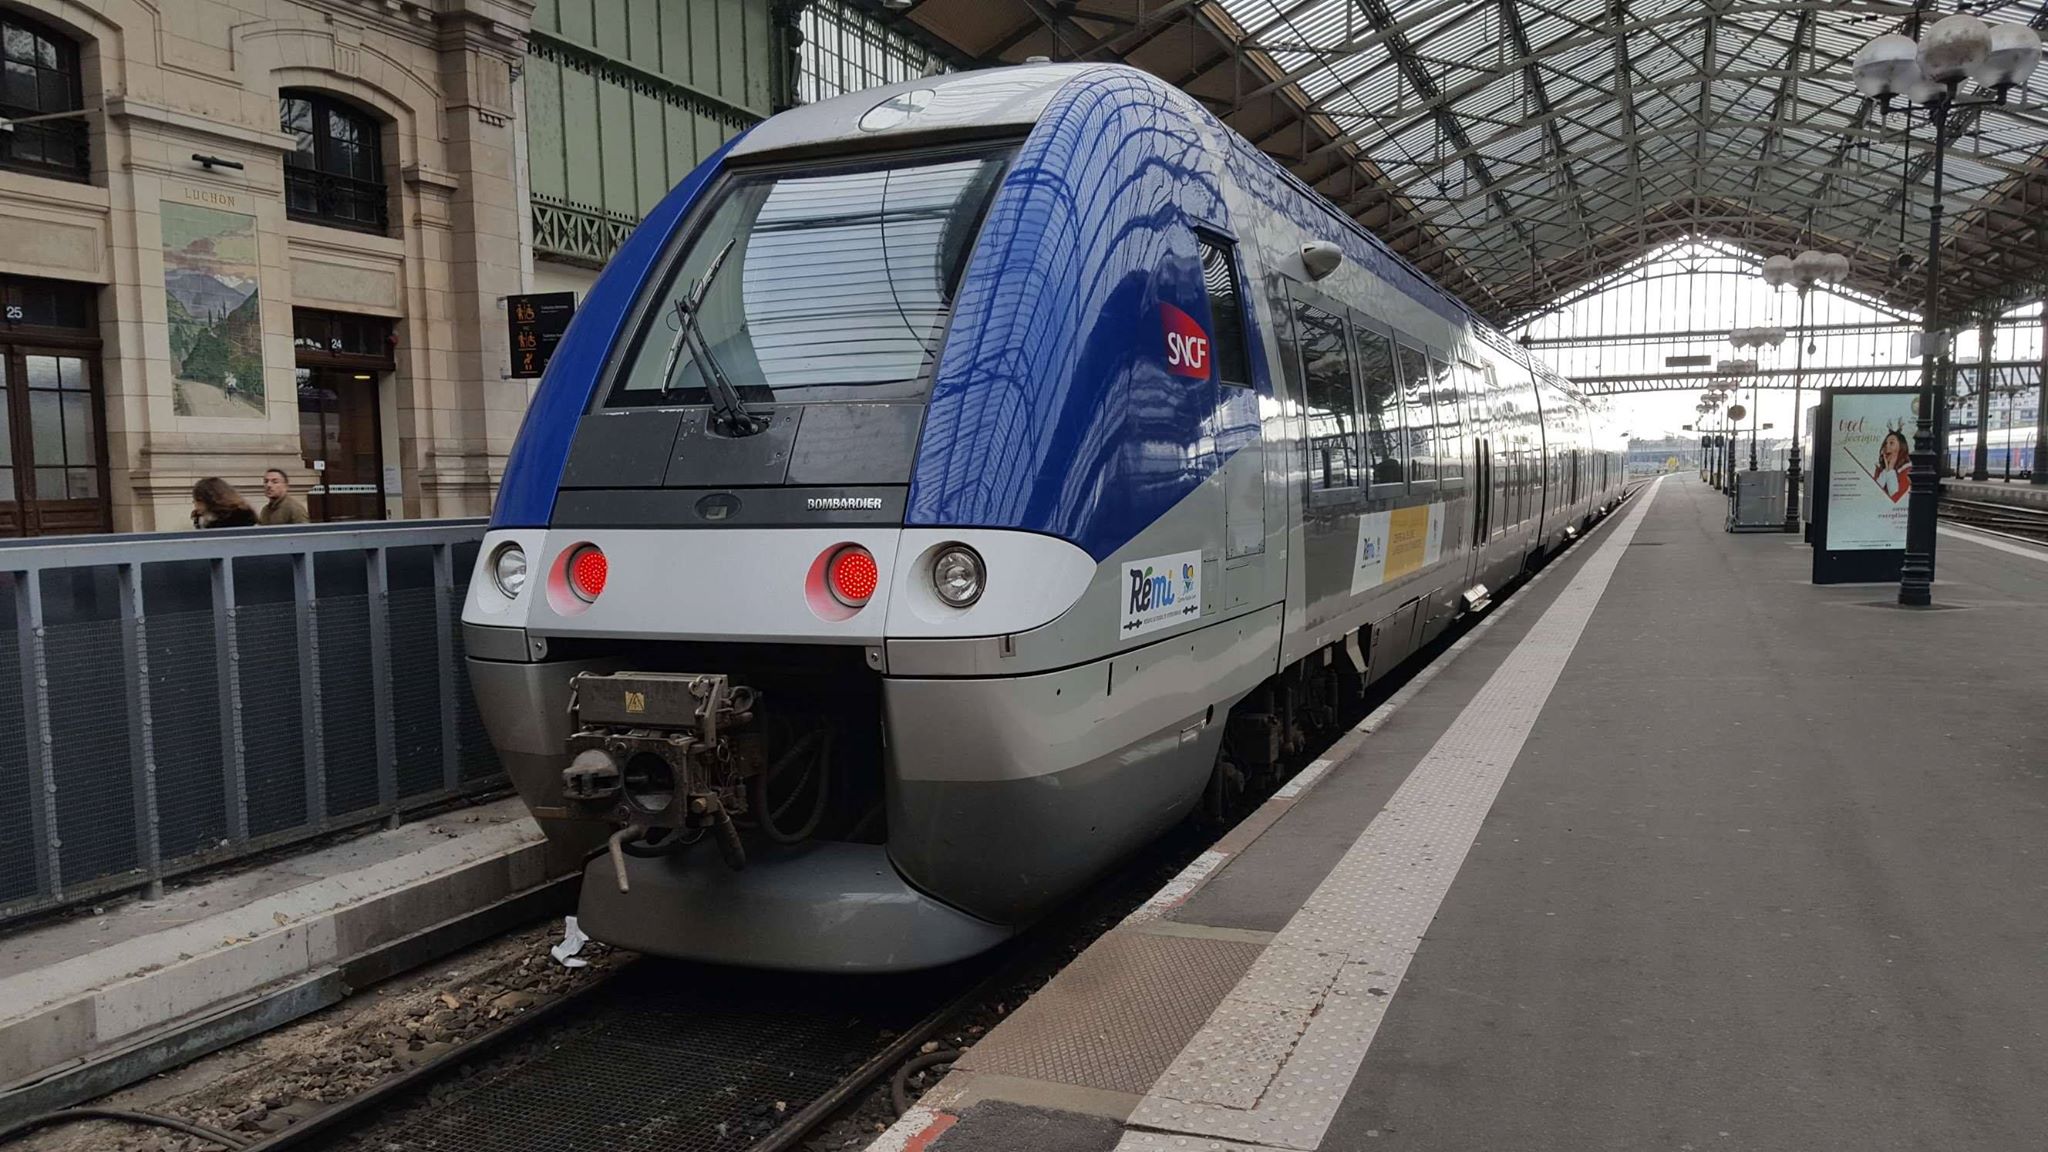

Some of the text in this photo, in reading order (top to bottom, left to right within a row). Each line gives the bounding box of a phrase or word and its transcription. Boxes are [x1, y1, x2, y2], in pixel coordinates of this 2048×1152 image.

[184, 187, 235, 207] LUCHON
[6, 306, 23, 319] 25
[331, 338, 342, 349] 24
[1168, 332, 1206, 369] SNCF
[807, 498, 882, 511] BOMBARDIER
[1129, 566, 1175, 615] Rémi
